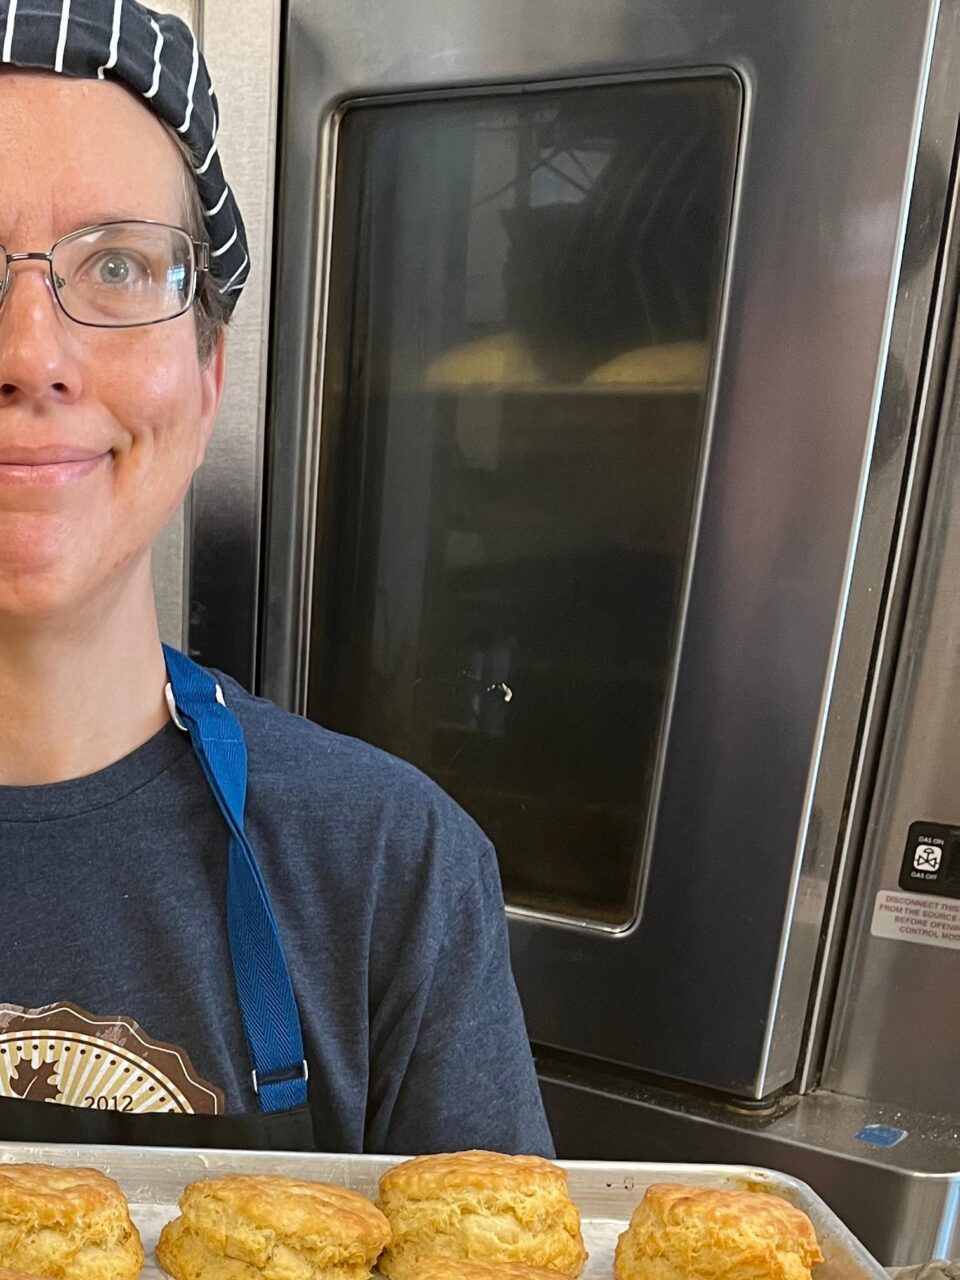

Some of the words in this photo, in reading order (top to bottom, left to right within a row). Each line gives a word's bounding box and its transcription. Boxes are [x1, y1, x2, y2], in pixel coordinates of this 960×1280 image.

[918, 836, 932, 844] GAS
[910, 871, 925, 879] GAS
[885, 895, 939, 909] DISCONNECT
[879, 904, 903, 914] FROM
[904, 907, 920, 917] THE
[922, 910, 957, 922] SOURCE
[894, 916, 928, 927] BEFORE
[899, 925, 939, 938] CONTROL
[85, 1095, 133, 1112] 2012
